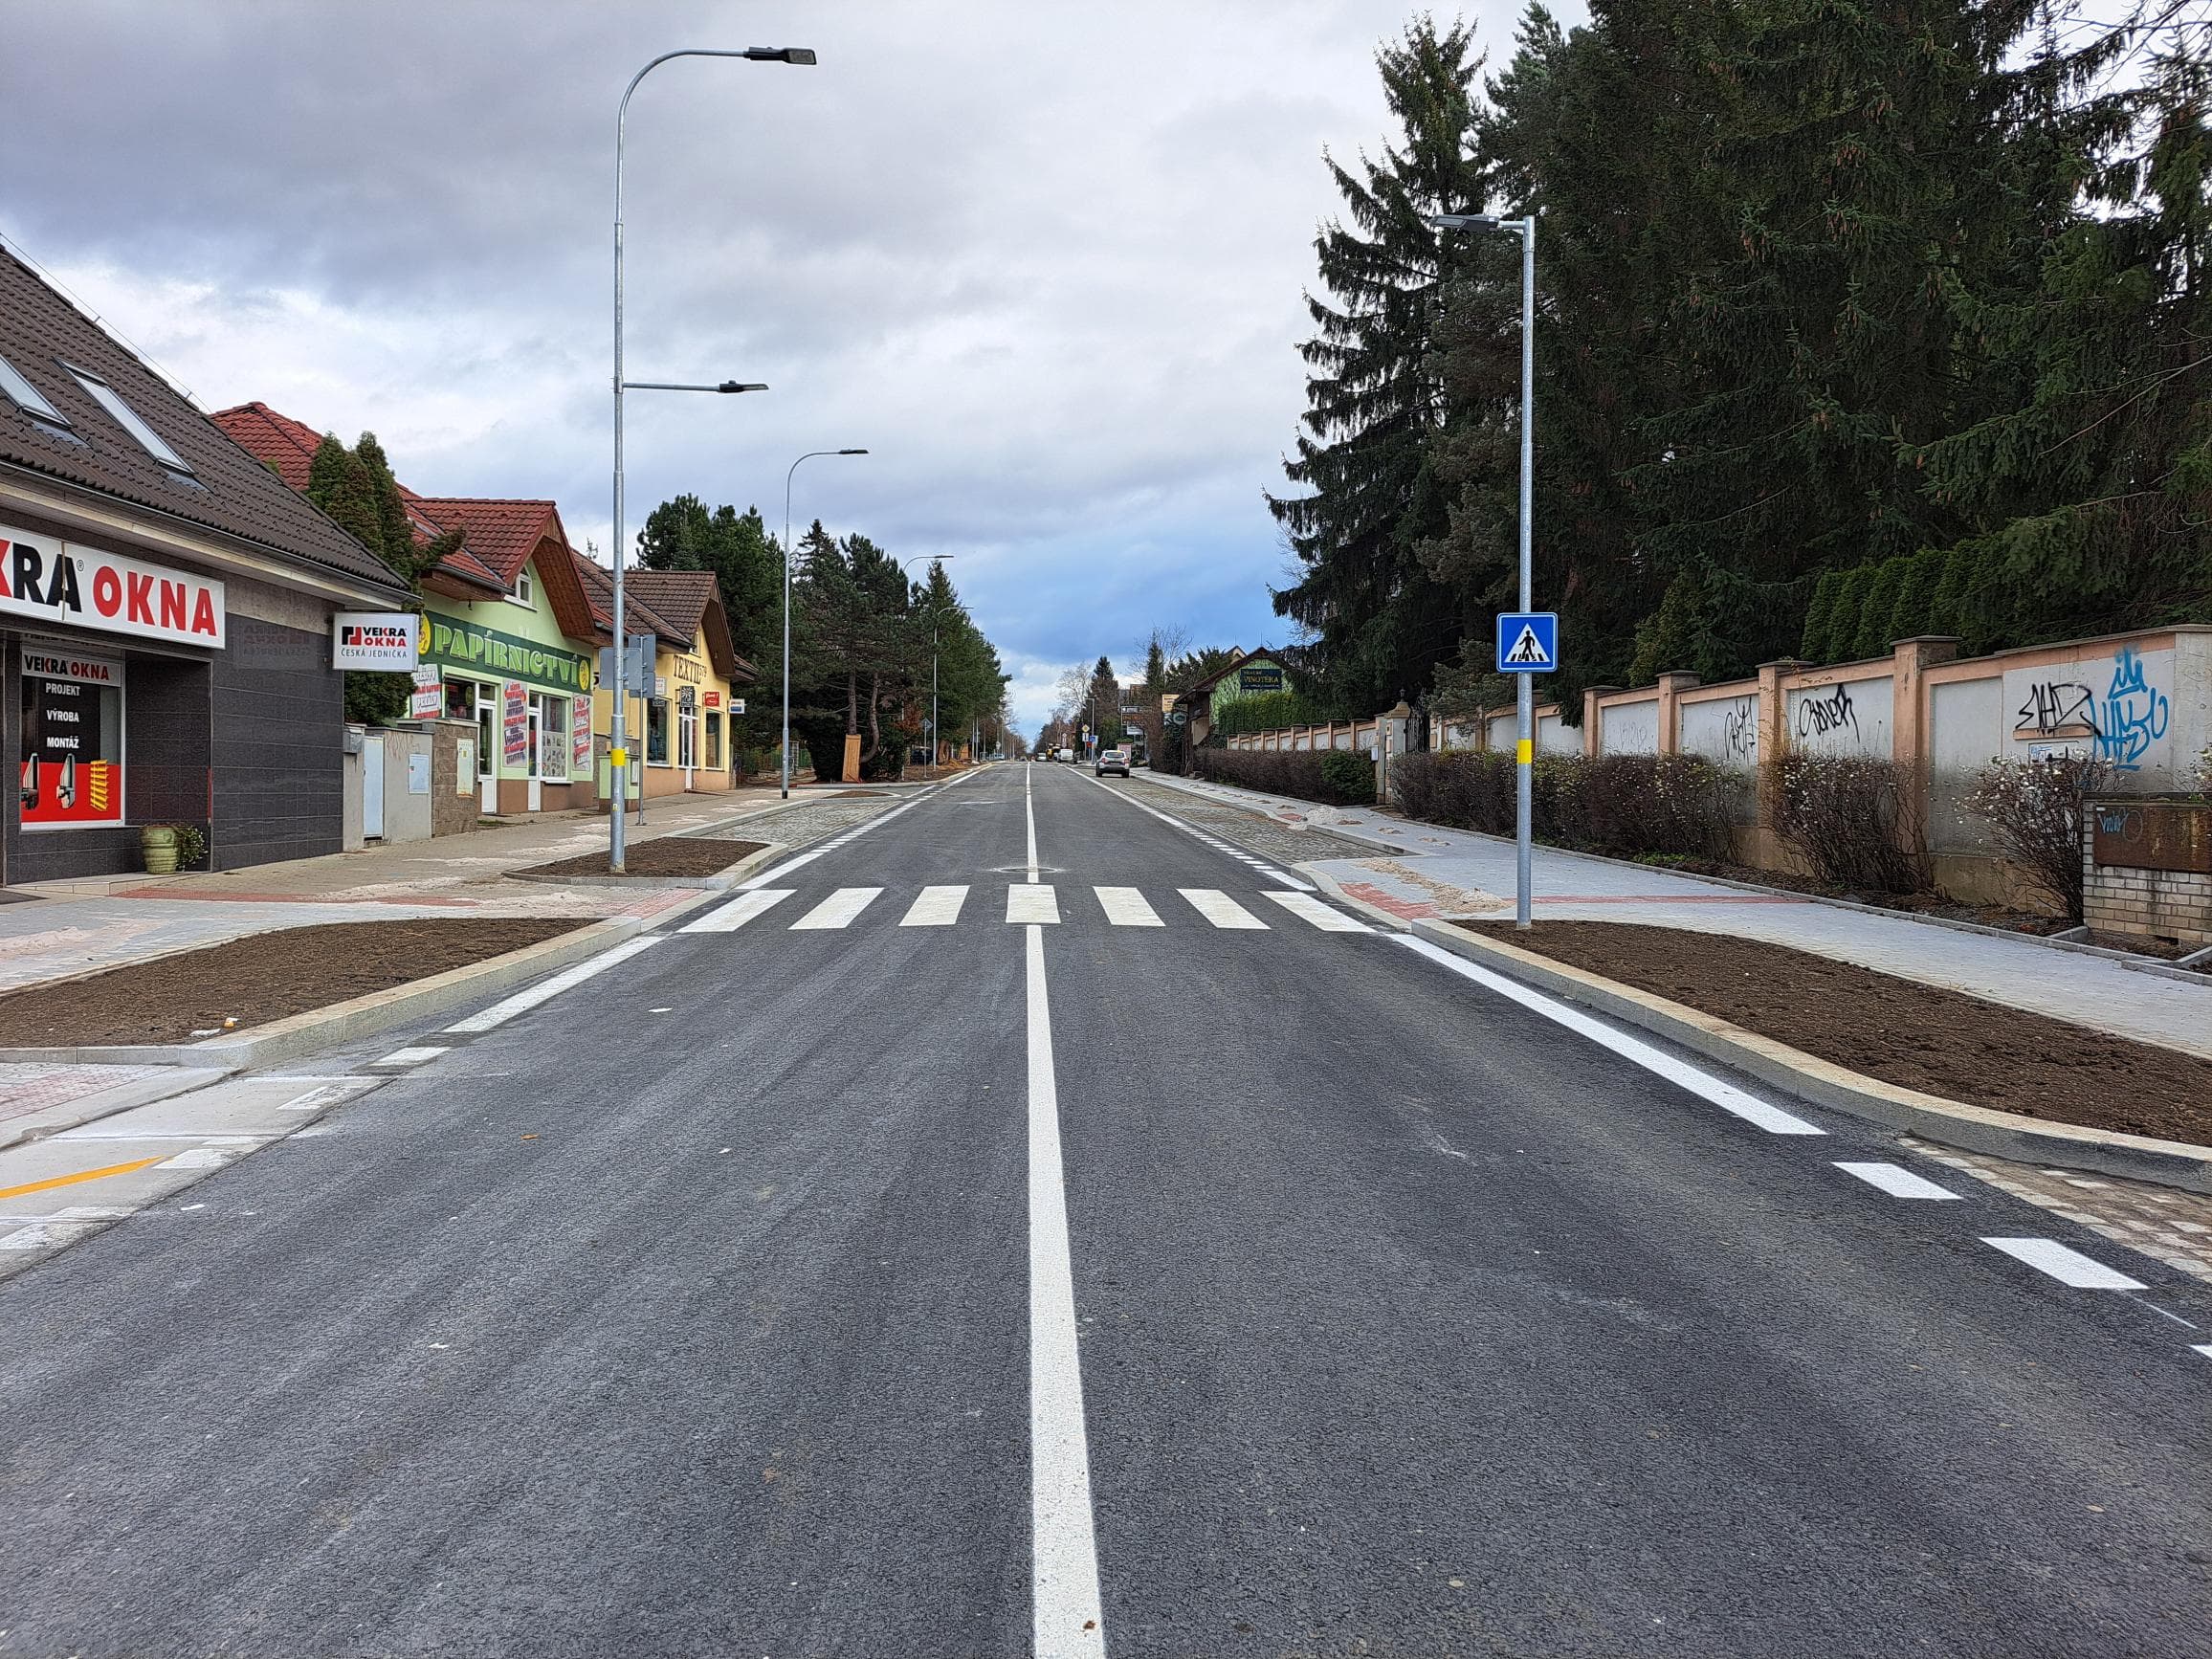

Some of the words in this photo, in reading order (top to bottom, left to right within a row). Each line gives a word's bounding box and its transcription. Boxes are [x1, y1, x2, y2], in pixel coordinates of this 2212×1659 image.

[93, 565, 217, 637] OKNA
[363, 627, 407, 637] VEKRA
[364, 637, 407, 647] OKNA
[341, 647, 365, 657] ČESKÁ
[368, 649, 408, 658] JEDNIČKA
[432, 623, 579, 685] PAPÍRNICTVÍ
[24, 654, 69, 675] VEKRA
[71, 661, 110, 680] OKNA
[674, 654, 700, 684] TEXTIL
[45, 682, 80, 697] PROJEKT
[46, 708, 79, 723] VÝROBA
[46, 736, 79, 749] MONTÁŽ
